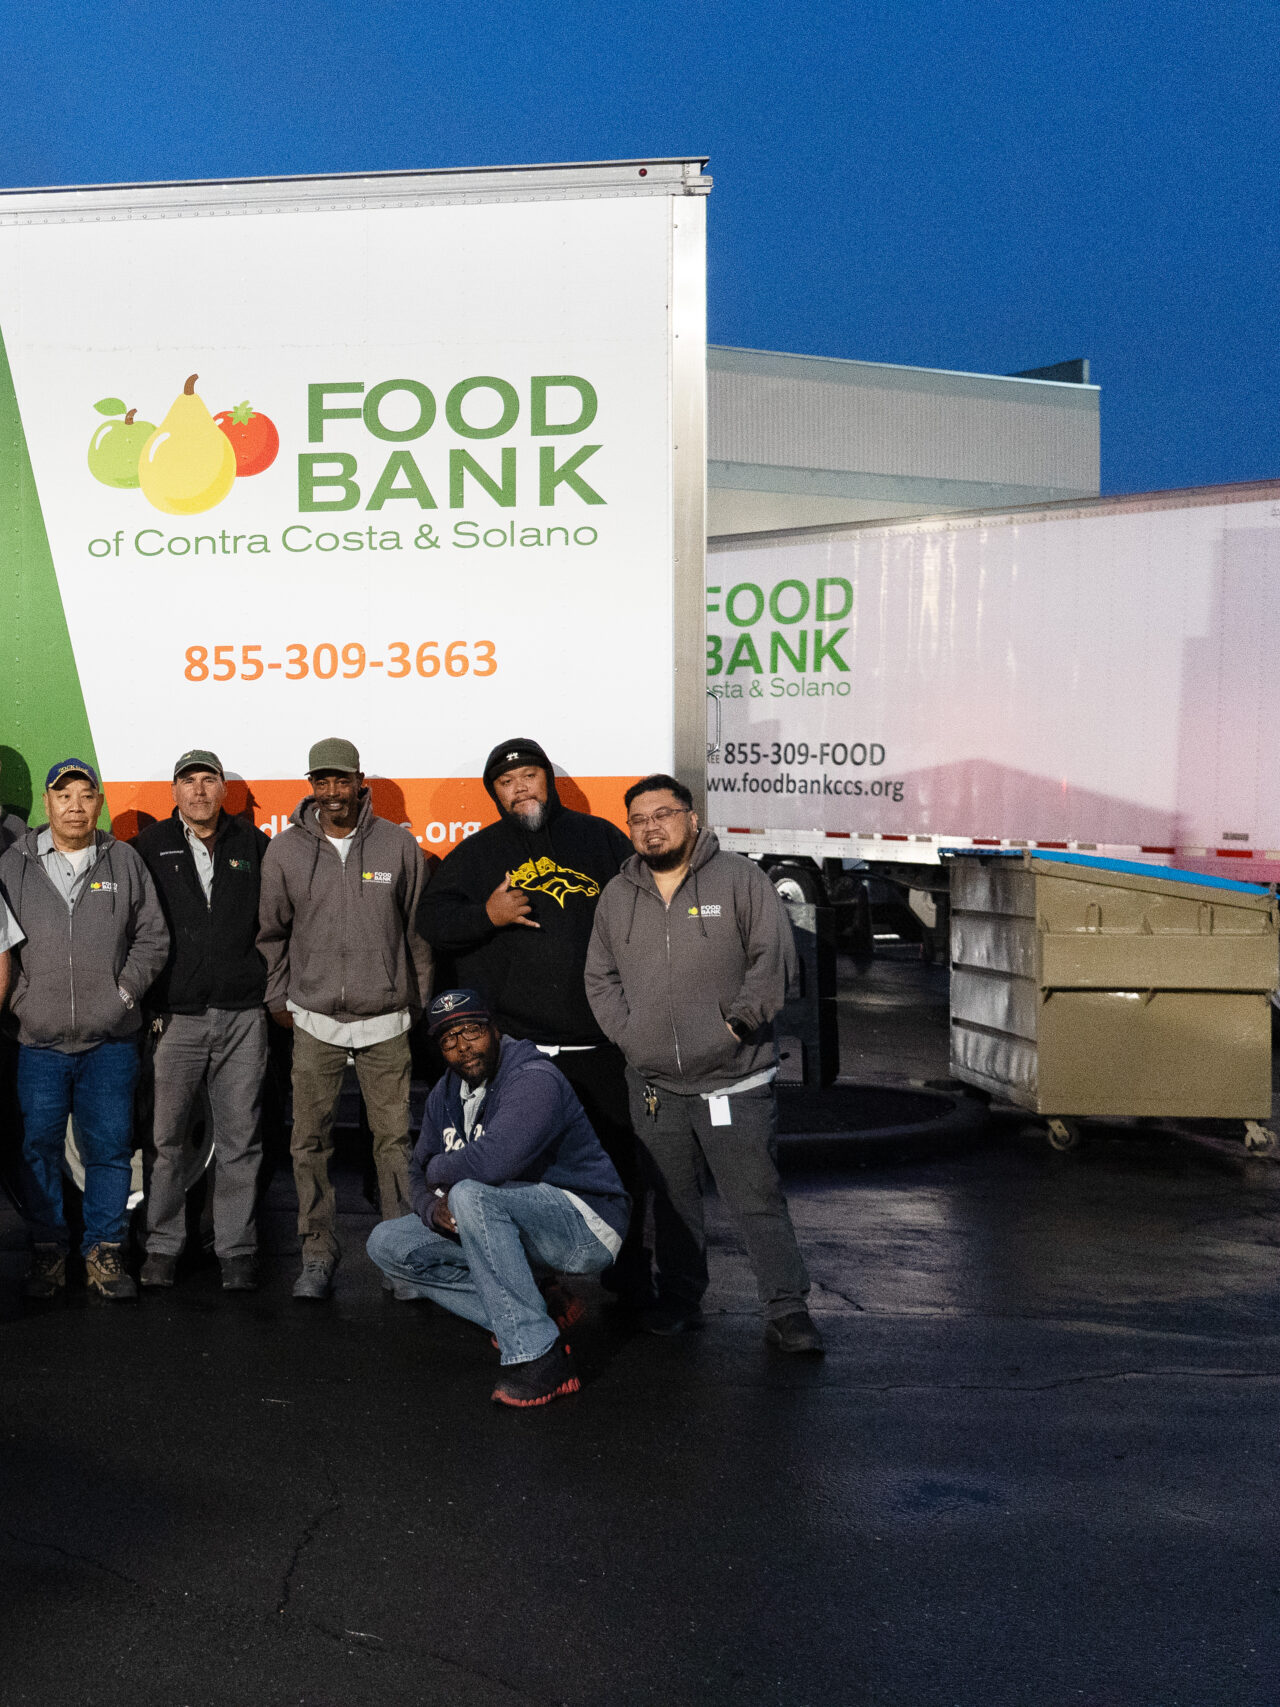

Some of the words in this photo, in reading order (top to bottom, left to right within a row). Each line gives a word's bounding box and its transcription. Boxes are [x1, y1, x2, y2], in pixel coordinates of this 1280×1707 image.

[307, 374, 599, 443] FOOD
[297, 444, 608, 513] BANK
[88, 531, 125, 557] of
[134, 528, 271, 557] Contra
[281, 525, 403, 553] Costa
[414, 523, 440, 549] &
[452, 520, 599, 550] Solano
[183, 640, 498, 682] 855-309-3663
[706, 684, 743, 698] sta
[748, 679, 764, 698] &
[770, 677, 852, 698] Solano
[724, 742, 886, 766] 855-309-FOOD
[706, 772, 904, 802] ww.foodbankccs.org
